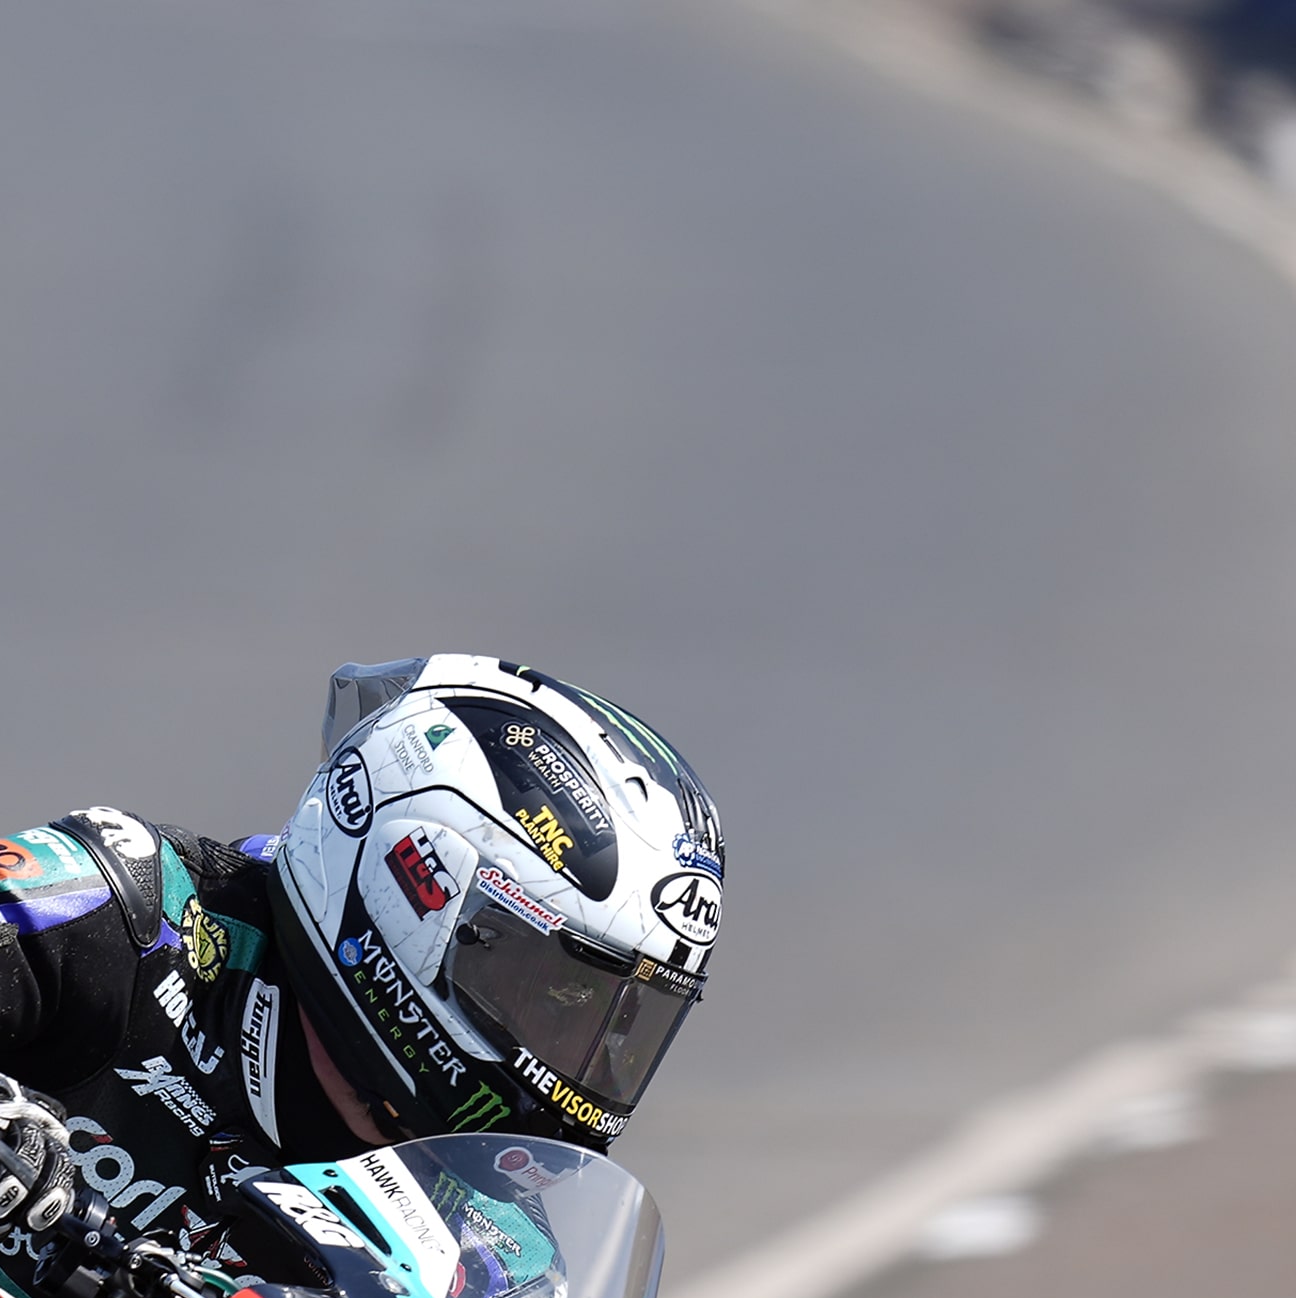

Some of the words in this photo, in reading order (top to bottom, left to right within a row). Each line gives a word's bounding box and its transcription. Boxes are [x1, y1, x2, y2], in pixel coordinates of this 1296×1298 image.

[394, 740, 416, 771] STONE
[404, 724, 434, 774] CRANFORD
[527, 751, 560, 788] WEALTH
[336, 762, 372, 826] Arai
[534, 745, 609, 830] PROSPERITY
[515, 808, 546, 849] PLANT
[532, 804, 574, 856] TNC
[353, 969, 430, 1074] ENERGY
[154, 1088, 206, 1138] Racing
[258, 1181, 365, 1250] R&G
